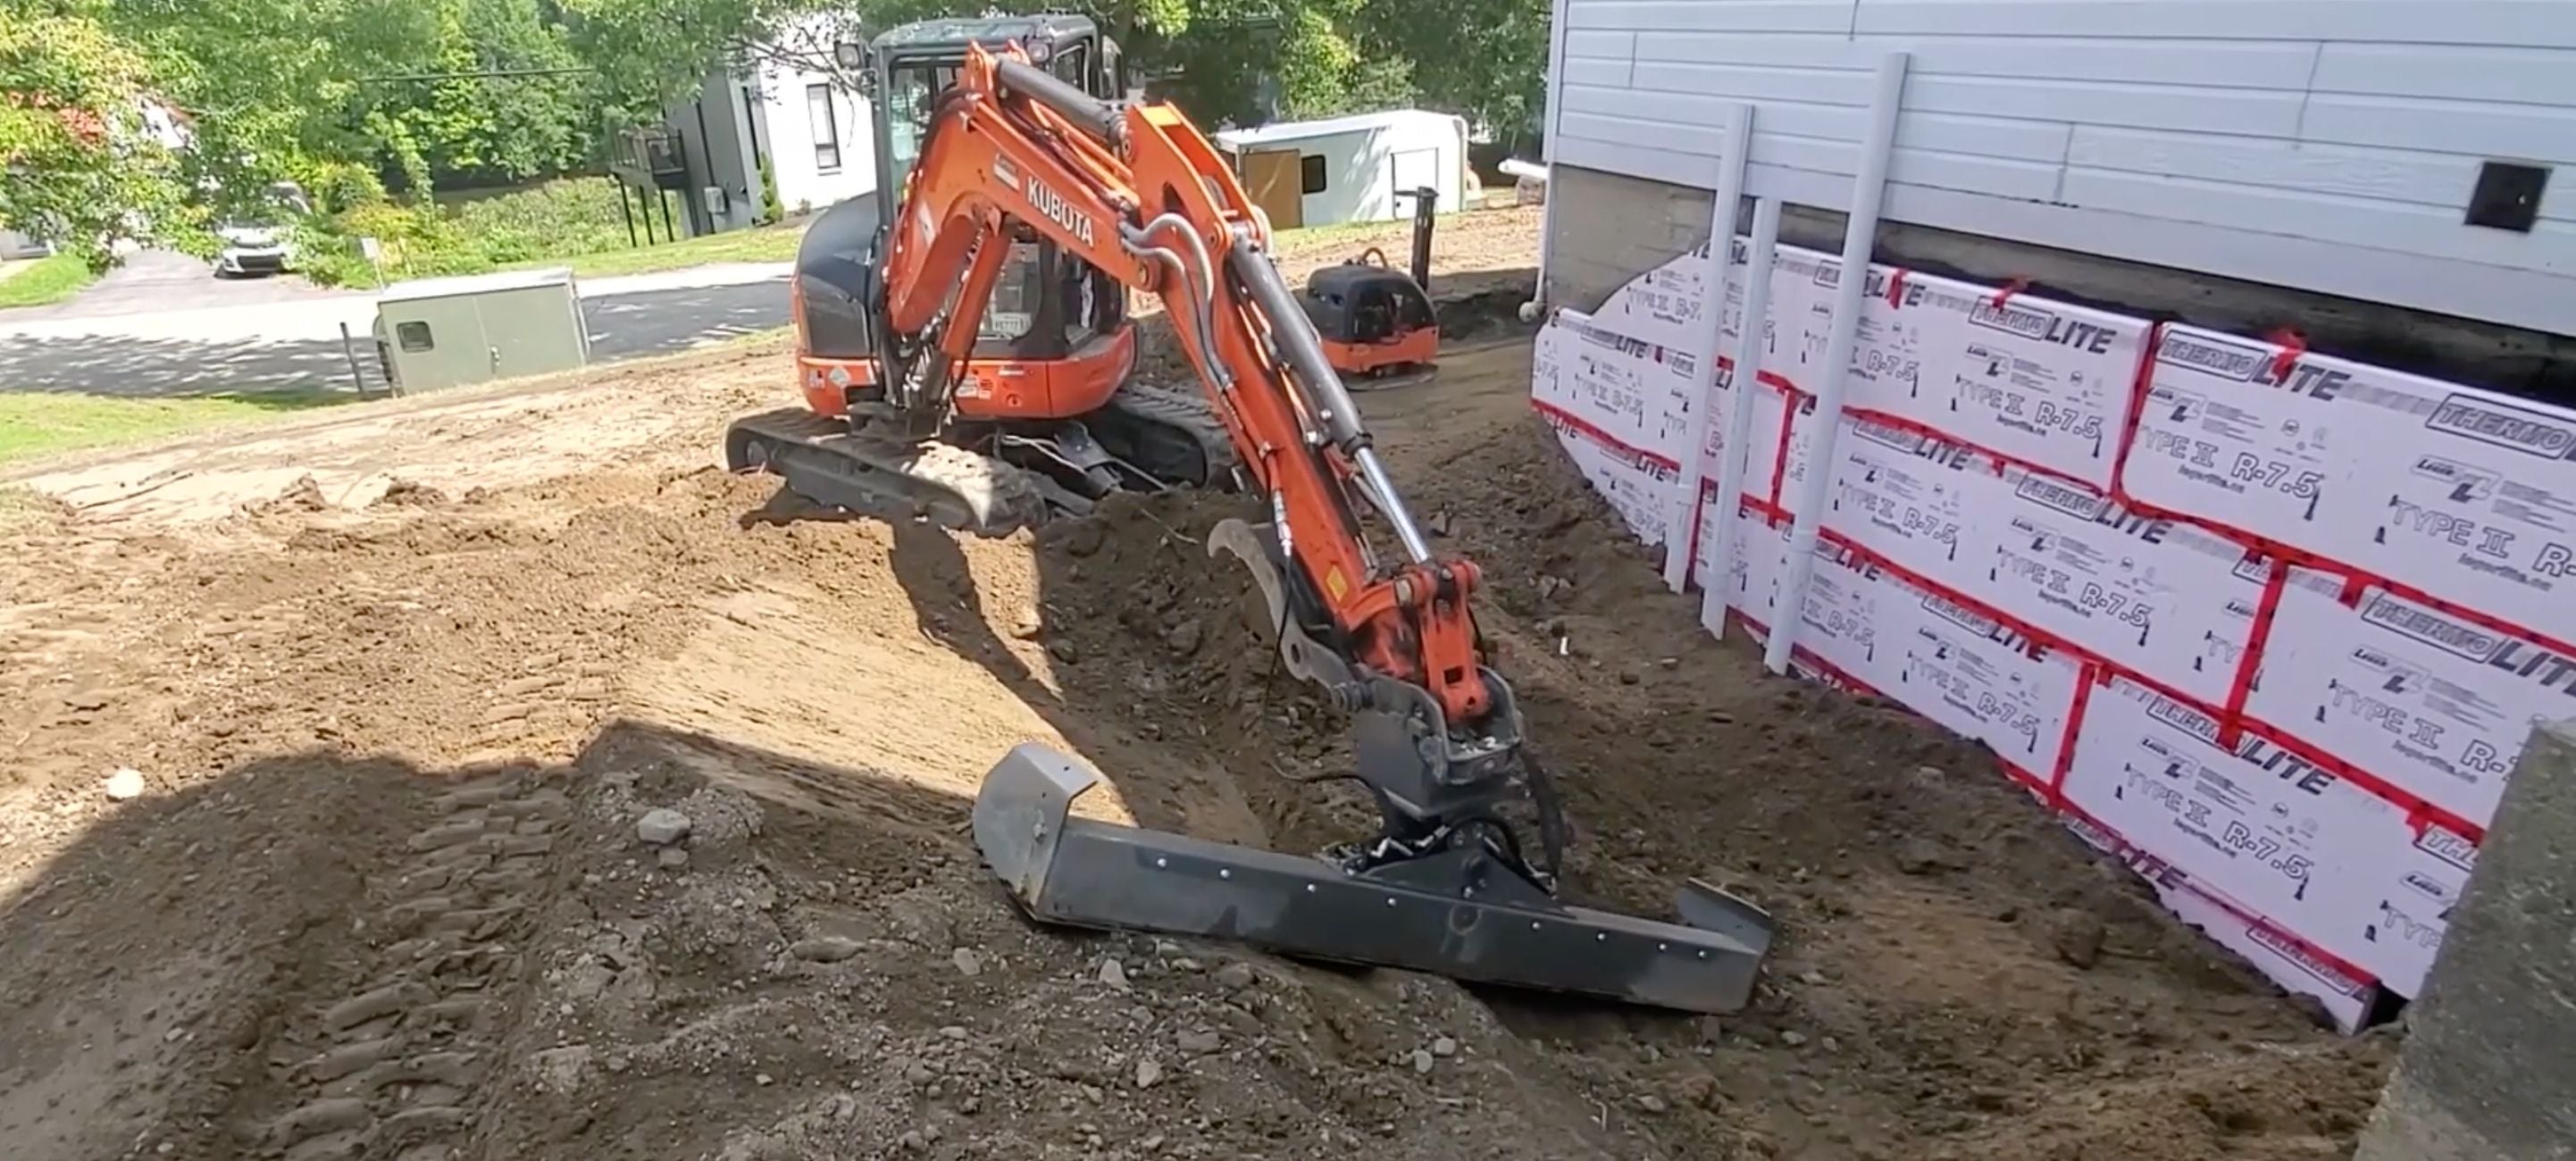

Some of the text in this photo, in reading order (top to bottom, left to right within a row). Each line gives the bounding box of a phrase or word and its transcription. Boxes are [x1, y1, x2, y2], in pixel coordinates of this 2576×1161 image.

[1028, 176, 1094, 248] KUBOTA
[1866, 349, 1920, 382] R-7.5
[2035, 401, 2105, 440] R-7.5
[2230, 451, 2326, 500] R-7.5
[1903, 506, 1961, 544] R-7.5
[2392, 499, 2476, 547] TYPE
[2476, 526, 2516, 559] II
[2079, 581, 2154, 628] R-7.5
[1977, 690, 2041, 736] R-7.5
[2331, 683, 2408, 735] TYPE
[2409, 717, 2446, 750] II
[2222, 820, 2315, 880] R-7.5
